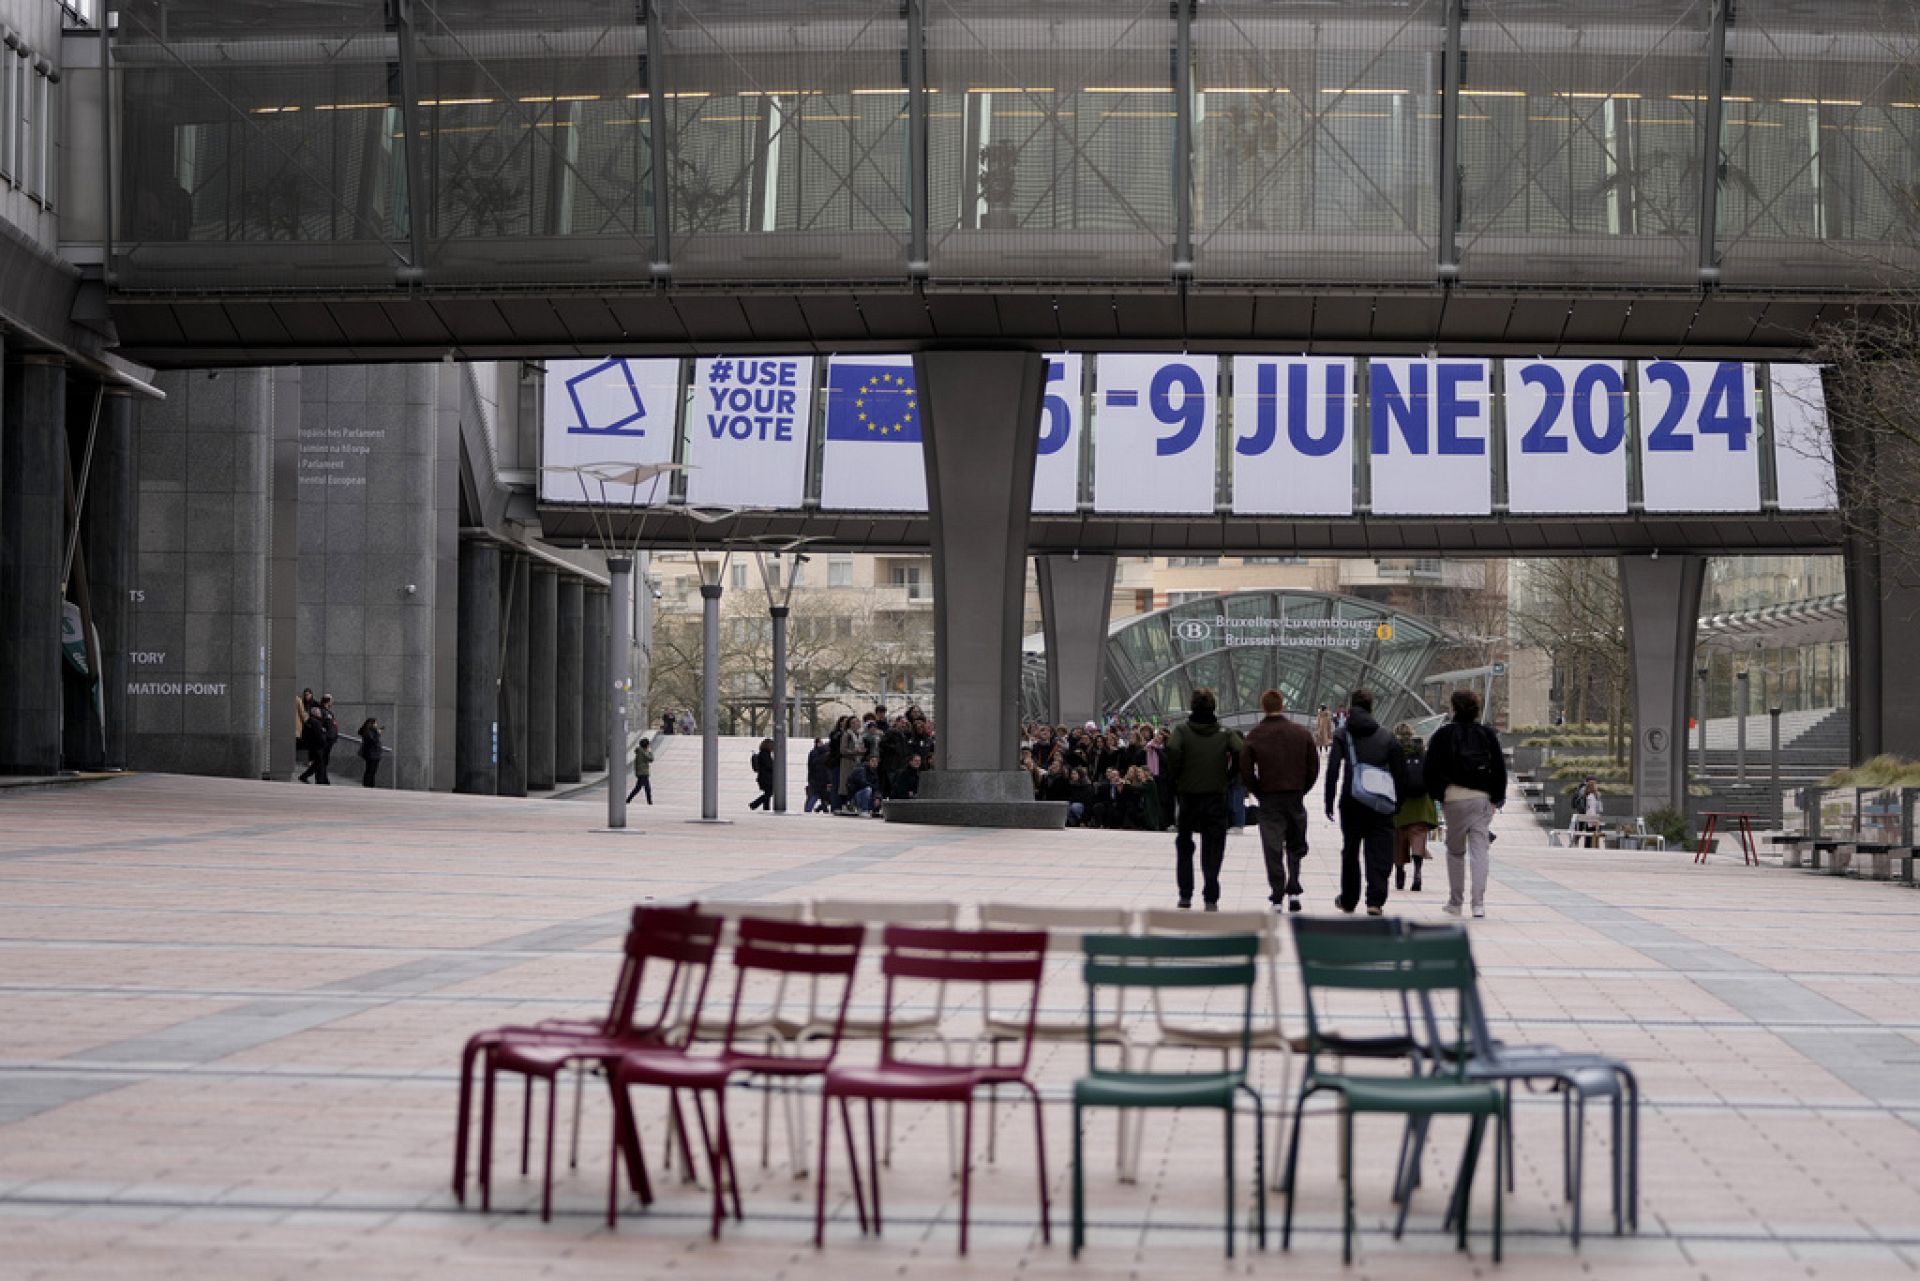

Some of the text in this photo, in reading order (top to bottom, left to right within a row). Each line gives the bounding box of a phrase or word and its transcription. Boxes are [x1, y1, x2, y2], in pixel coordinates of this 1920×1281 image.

[709, 360, 797, 386] #USE
[709, 387, 796, 414] YOUR
[1235, 363, 1485, 457] JUNE
[1519, 360, 1752, 455] 2024
[707, 414, 794, 441] VOTE
[129, 652, 166, 664] TORY
[127, 683, 227, 695] MATION POINT
